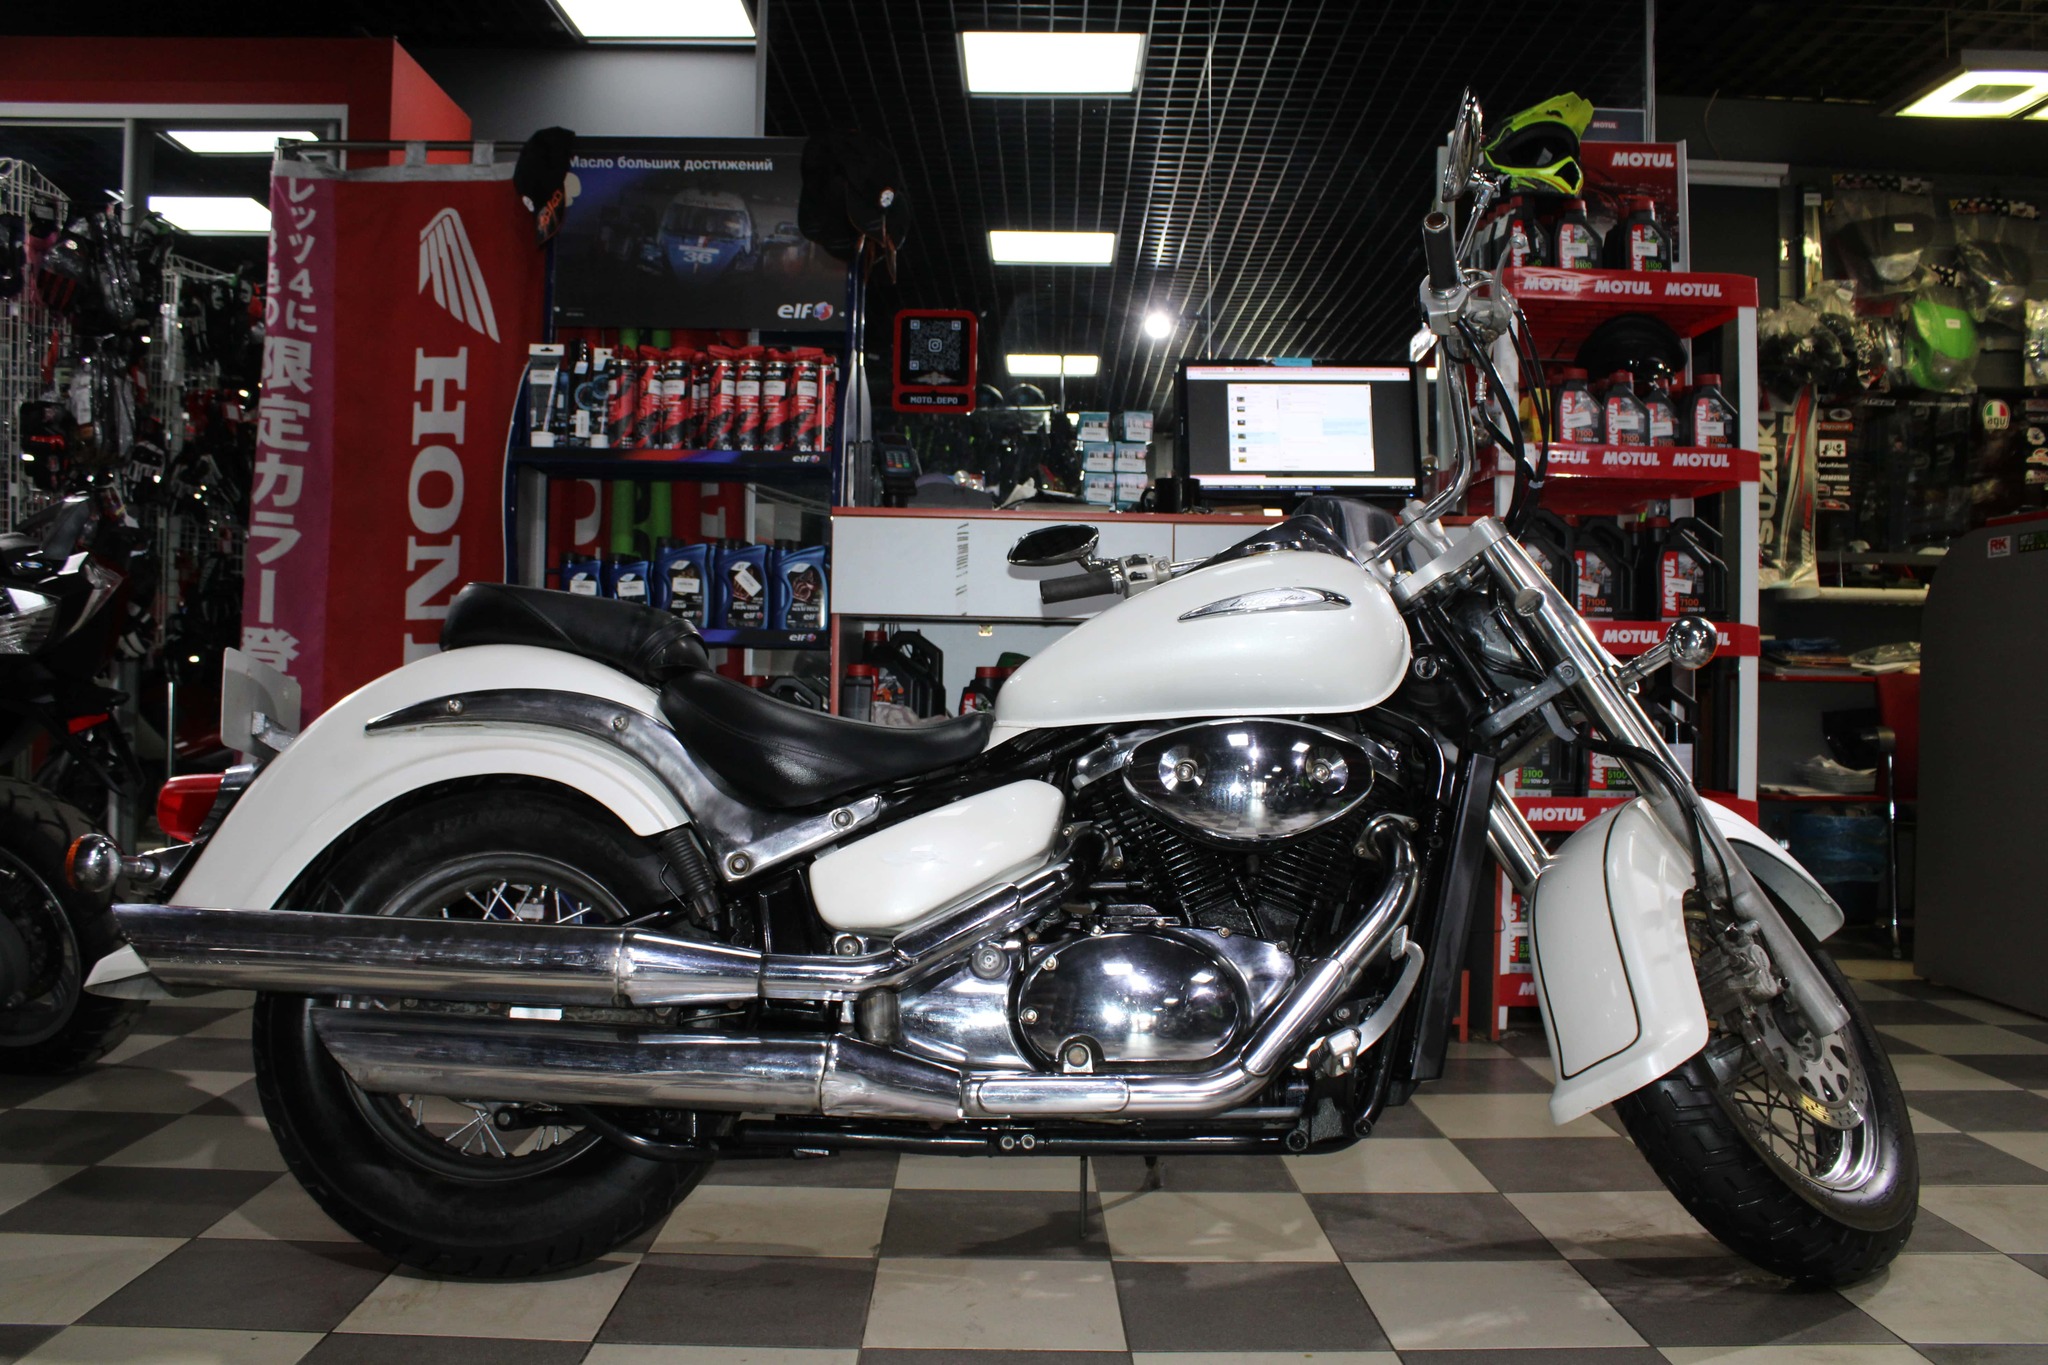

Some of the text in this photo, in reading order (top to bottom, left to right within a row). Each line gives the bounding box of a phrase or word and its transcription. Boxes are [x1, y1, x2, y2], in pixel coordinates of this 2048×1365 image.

[569, 155, 774, 172] Масло больших достижений
[1611, 152, 1674, 168] MOTUL
[683, 250, 713, 265] 36
[1523, 277, 1723, 298] MOTUL MOTUL MOTUL
[776, 301, 814, 320] elf
[792, 454, 810, 463] elf
[1602, 451, 1661, 466] MOTUL
[1672, 453, 1731, 468] MOTUL
[1990, 537, 2007, 550] RK
[1586, 598, 1606, 606] 7100
[1680, 598, 1699, 606] 7100
[788, 633, 807, 642] elf
[1602, 629, 1661, 644] MOTUL
[1522, 768, 1544, 779] 5100
[1527, 807, 1586, 821] MOTUL
